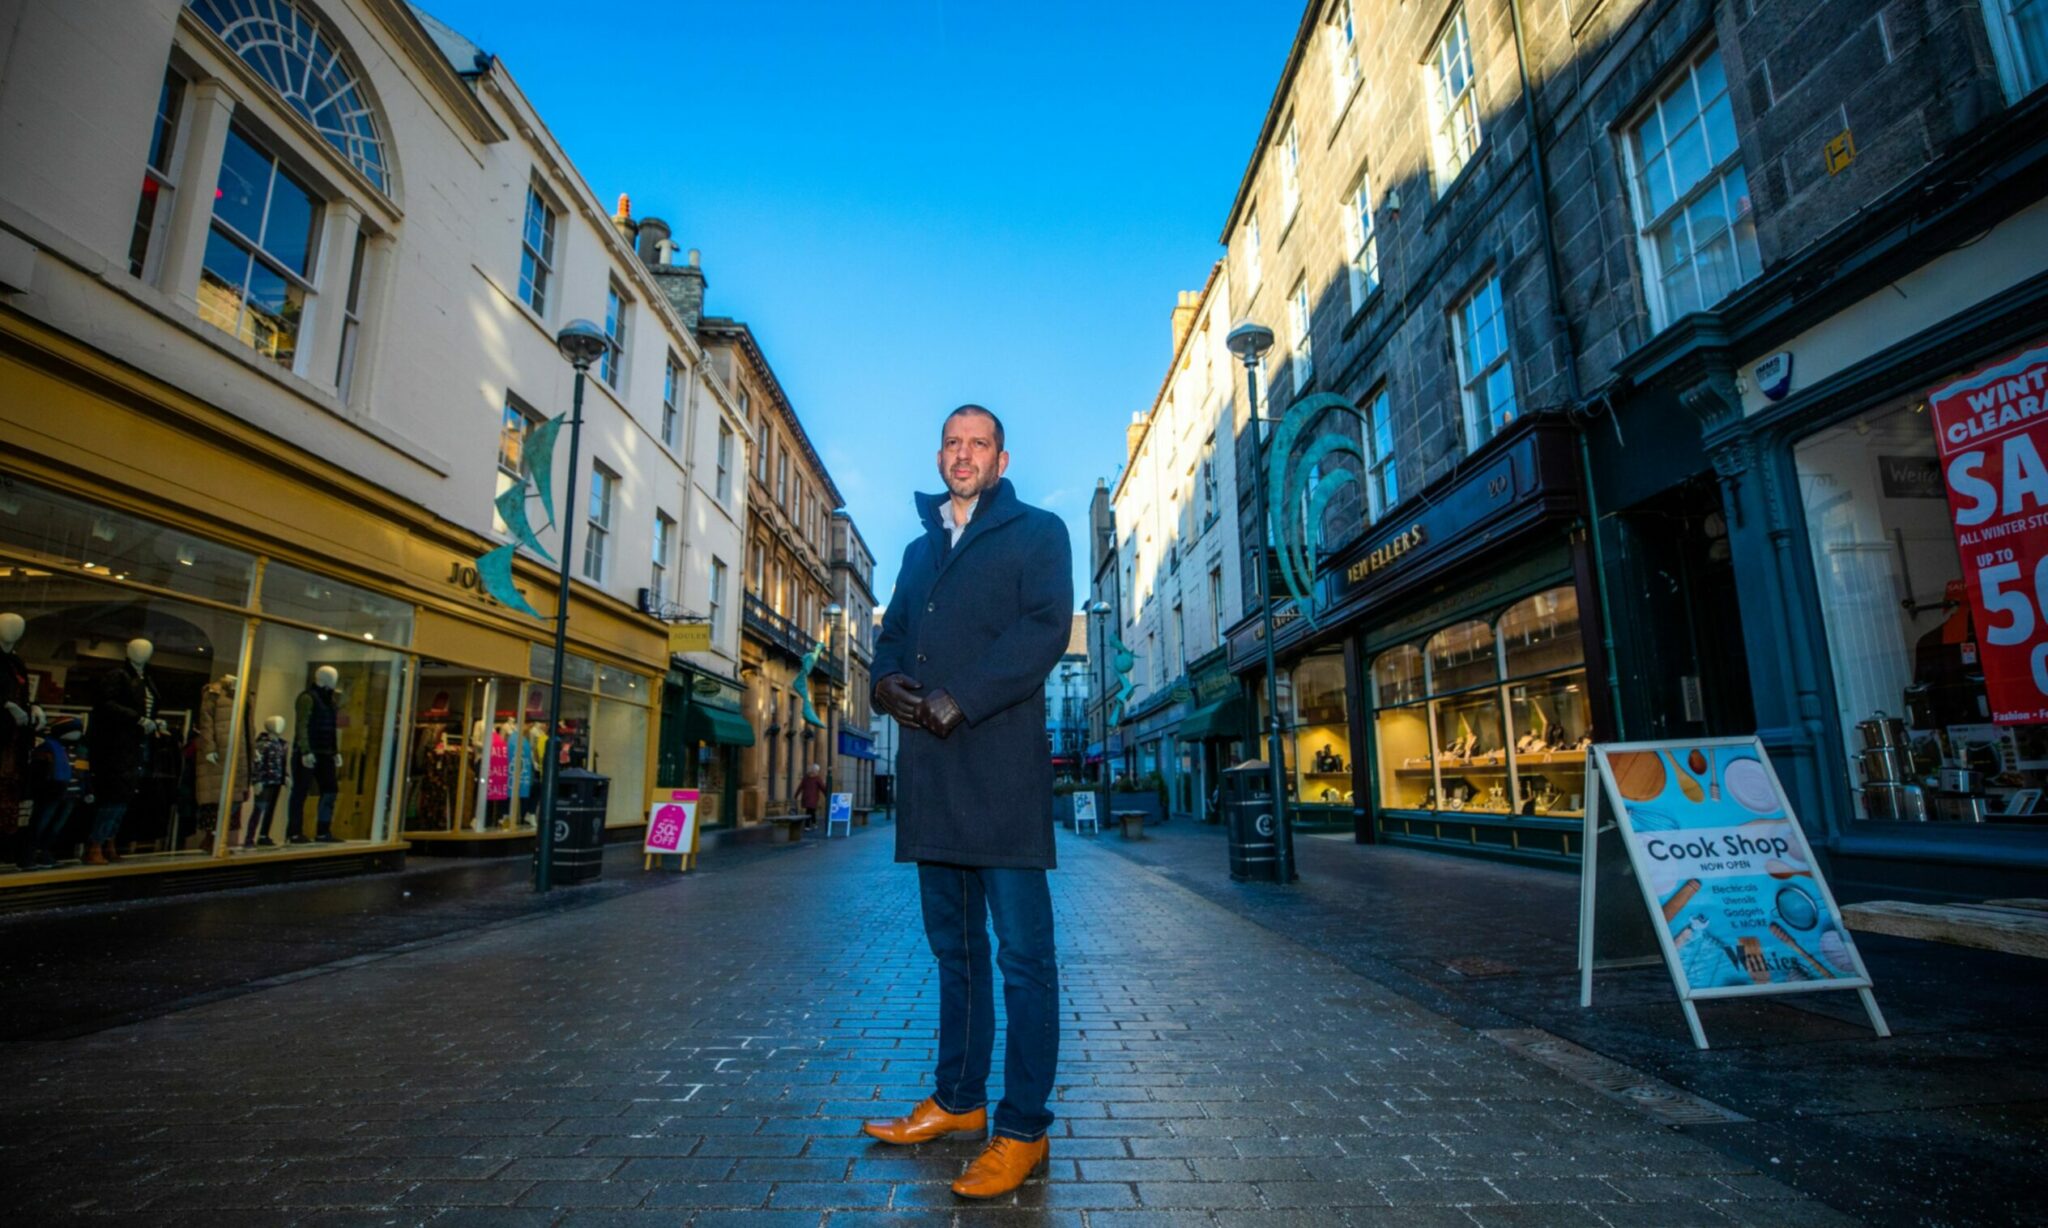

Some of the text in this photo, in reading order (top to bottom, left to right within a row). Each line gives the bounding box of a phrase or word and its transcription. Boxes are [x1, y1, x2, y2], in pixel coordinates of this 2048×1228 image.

[1967, 366, 2048, 414] WINT
[1947, 432, 2048, 526] SA
[1960, 532, 1981, 547] ALL
[1982, 519, 2027, 542] WINTER
[1347, 523, 1424, 585] JEWELLERS
[1976, 548, 2014, 568] UP TO
[1993, 710, 2030, 721] Fashion
[652, 834, 677, 846] OFF
[1648, 834, 1788, 861] Cook Shop
[1701, 860, 1751, 871] NOW OPEN
[1712, 884, 1759, 894] Electricals
[1723, 908, 1764, 917] Gadgets
[1724, 945, 1802, 973] Wilkies
